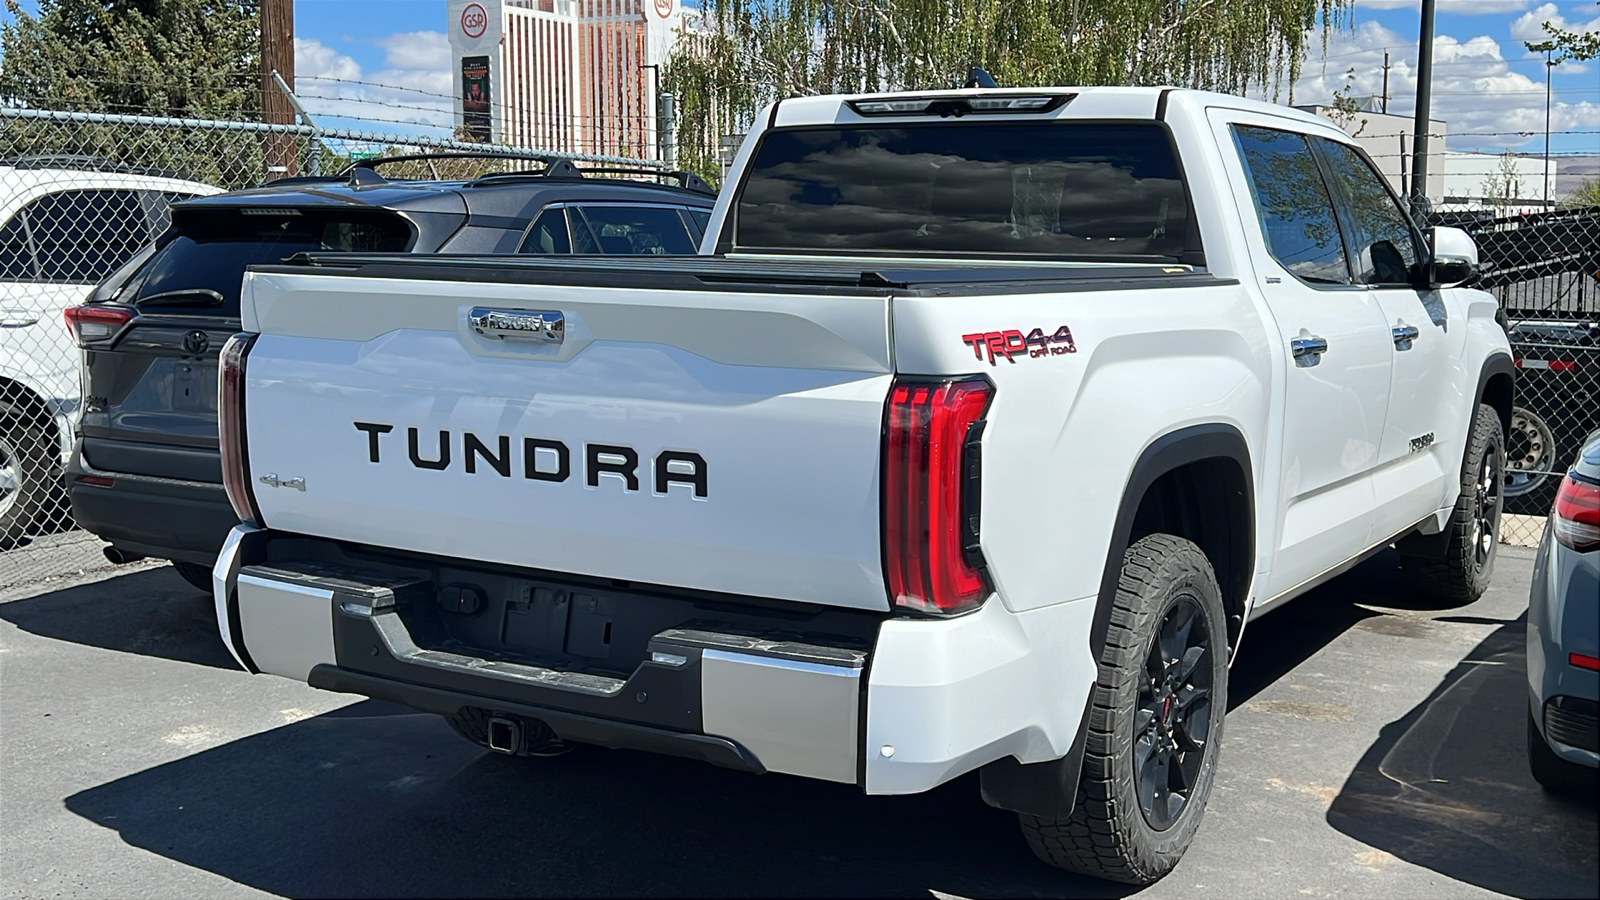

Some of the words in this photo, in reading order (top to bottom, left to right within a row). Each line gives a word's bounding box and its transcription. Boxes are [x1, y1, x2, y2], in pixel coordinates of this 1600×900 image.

[465, 14, 484, 28] GSR
[962, 329, 1029, 366] TRD
[1026, 325, 1075, 348] 4x4
[1030, 347, 1049, 359] OFF
[1051, 345, 1077, 356] ROAD
[353, 422, 708, 499] TUNDRA
[259, 472, 307, 492] 4x4
